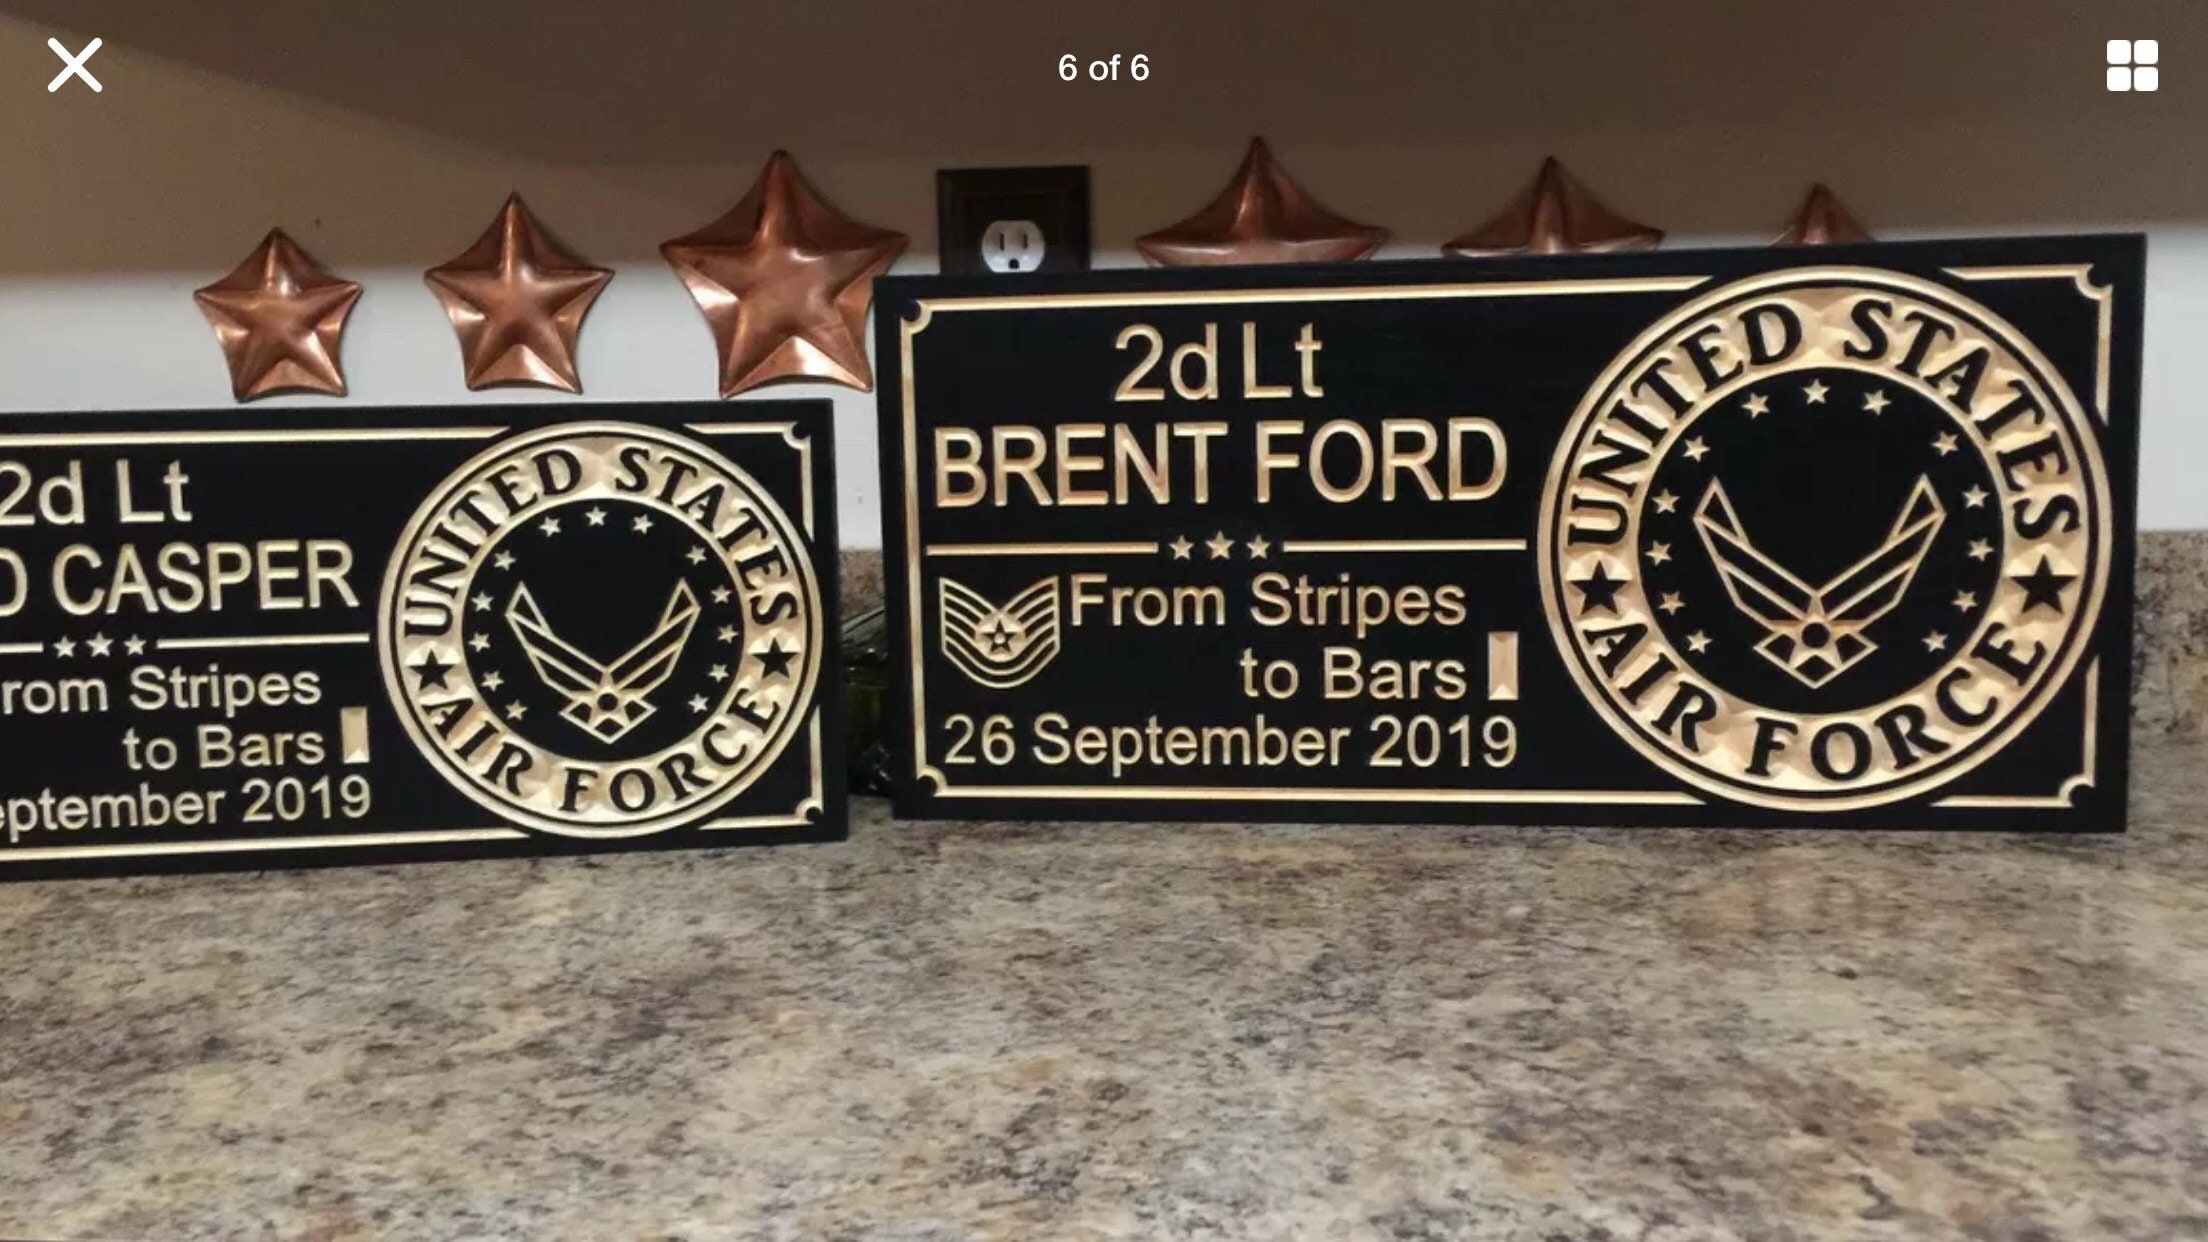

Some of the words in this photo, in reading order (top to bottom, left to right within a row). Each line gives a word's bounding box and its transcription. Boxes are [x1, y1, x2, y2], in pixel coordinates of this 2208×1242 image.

[1114, 323, 1219, 402] 2d
[1242, 322, 1325, 399] Lt
[1567, 303, 1803, 548] UNITED
[1843, 298, 2081, 540] STATES
[0, 460, 86, 526] 2d
[115, 458, 194, 524] Lt
[934, 421, 1229, 507] BRENT
[1255, 417, 1508, 503] FORD
[51, 539, 360, 616] CASPER
[402, 445, 584, 637] UNITED
[614, 446, 800, 627] STATES
[1070, 573, 1226, 627] From
[1250, 572, 1468, 638] Stripes
[0, 680, 109, 716] rom
[129, 664, 322, 716] Stripes
[1239, 648, 1299, 697] to
[1323, 648, 1468, 700] Bars
[1582, 624, 1718, 752] AIR
[1744, 620, 2048, 782] FORCE
[122, 727, 178, 771] to
[199, 722, 326, 768] Bars
[424, 696, 531, 797] AIR
[558, 686, 780, 813] FORCE
[944, 713, 1016, 766] 26
[1032, 713, 1352, 778] September
[1369, 714, 1518, 767] 2019
[0, 781, 226, 843] ptember
[240, 774, 371, 823] 2019
